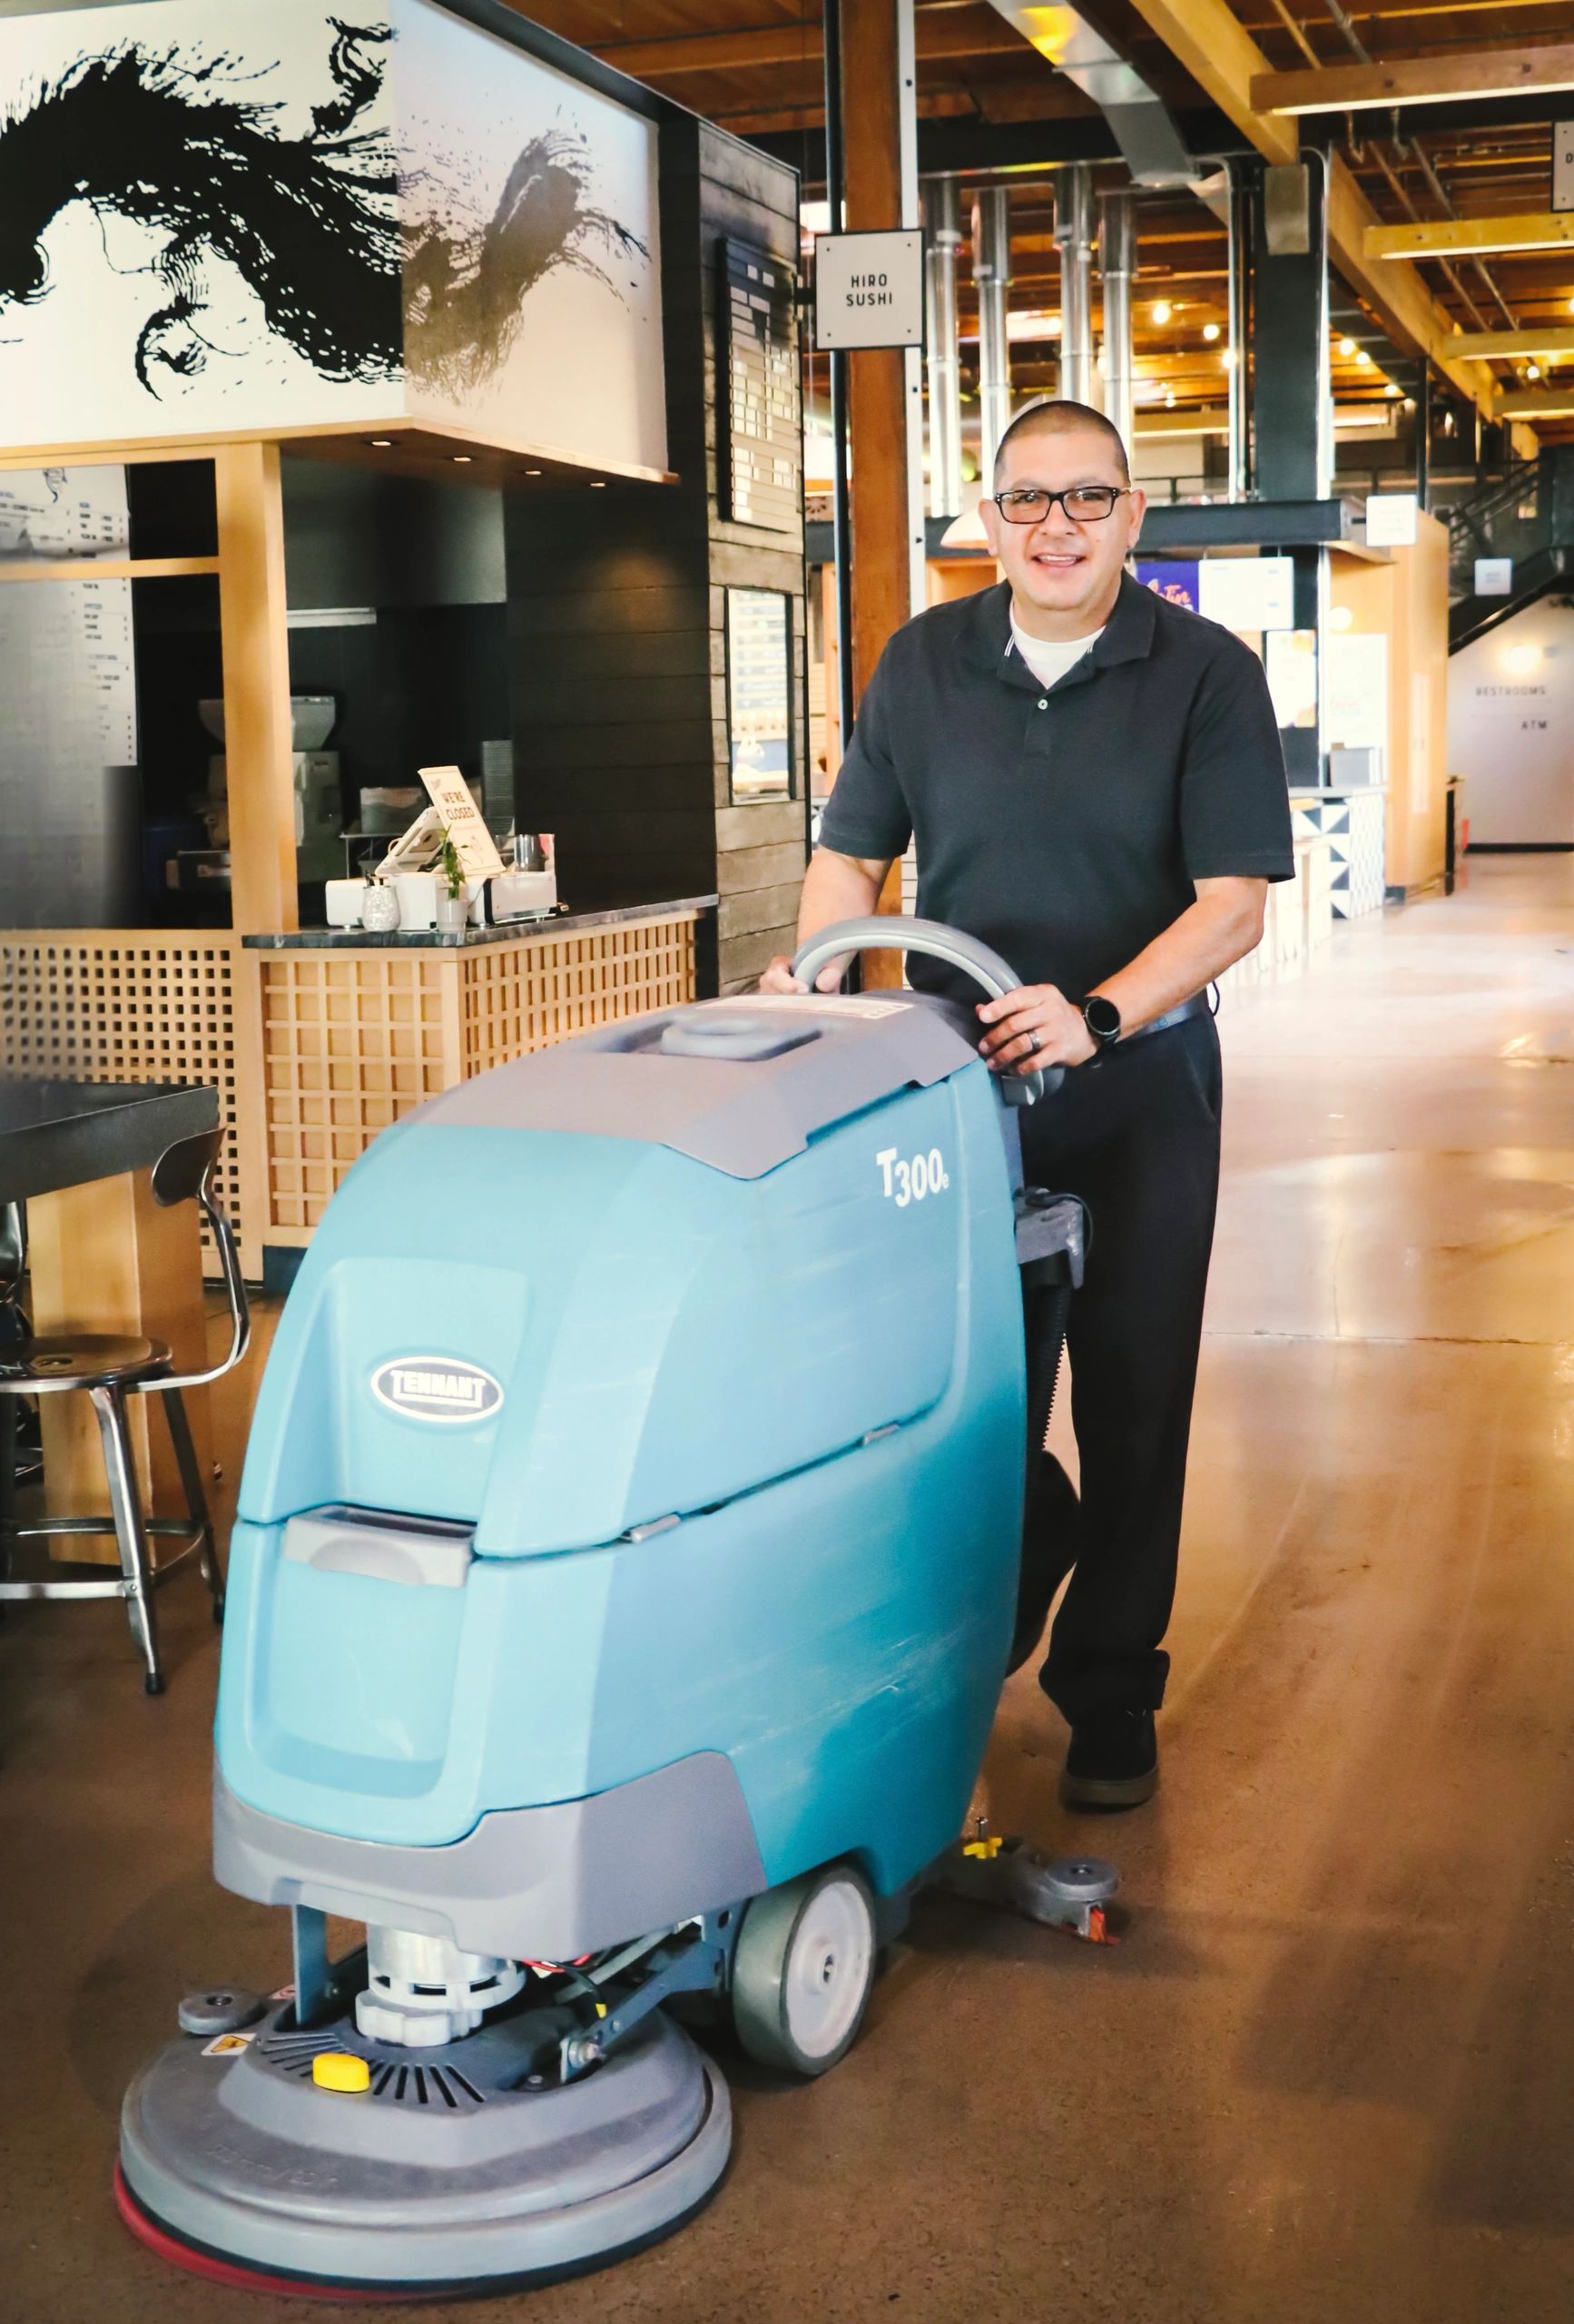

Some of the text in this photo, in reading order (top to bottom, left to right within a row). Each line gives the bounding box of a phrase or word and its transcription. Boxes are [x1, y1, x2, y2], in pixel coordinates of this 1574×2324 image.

[851, 273, 887, 288] HIRO
[846, 292, 892, 307] SUSHI
[1476, 686, 1546, 696] RESTROOMS
[1521, 720, 1548, 729] ATM
[446, 807, 475, 820] CLOSED
[390, 1369, 487, 1408] TENNANT
